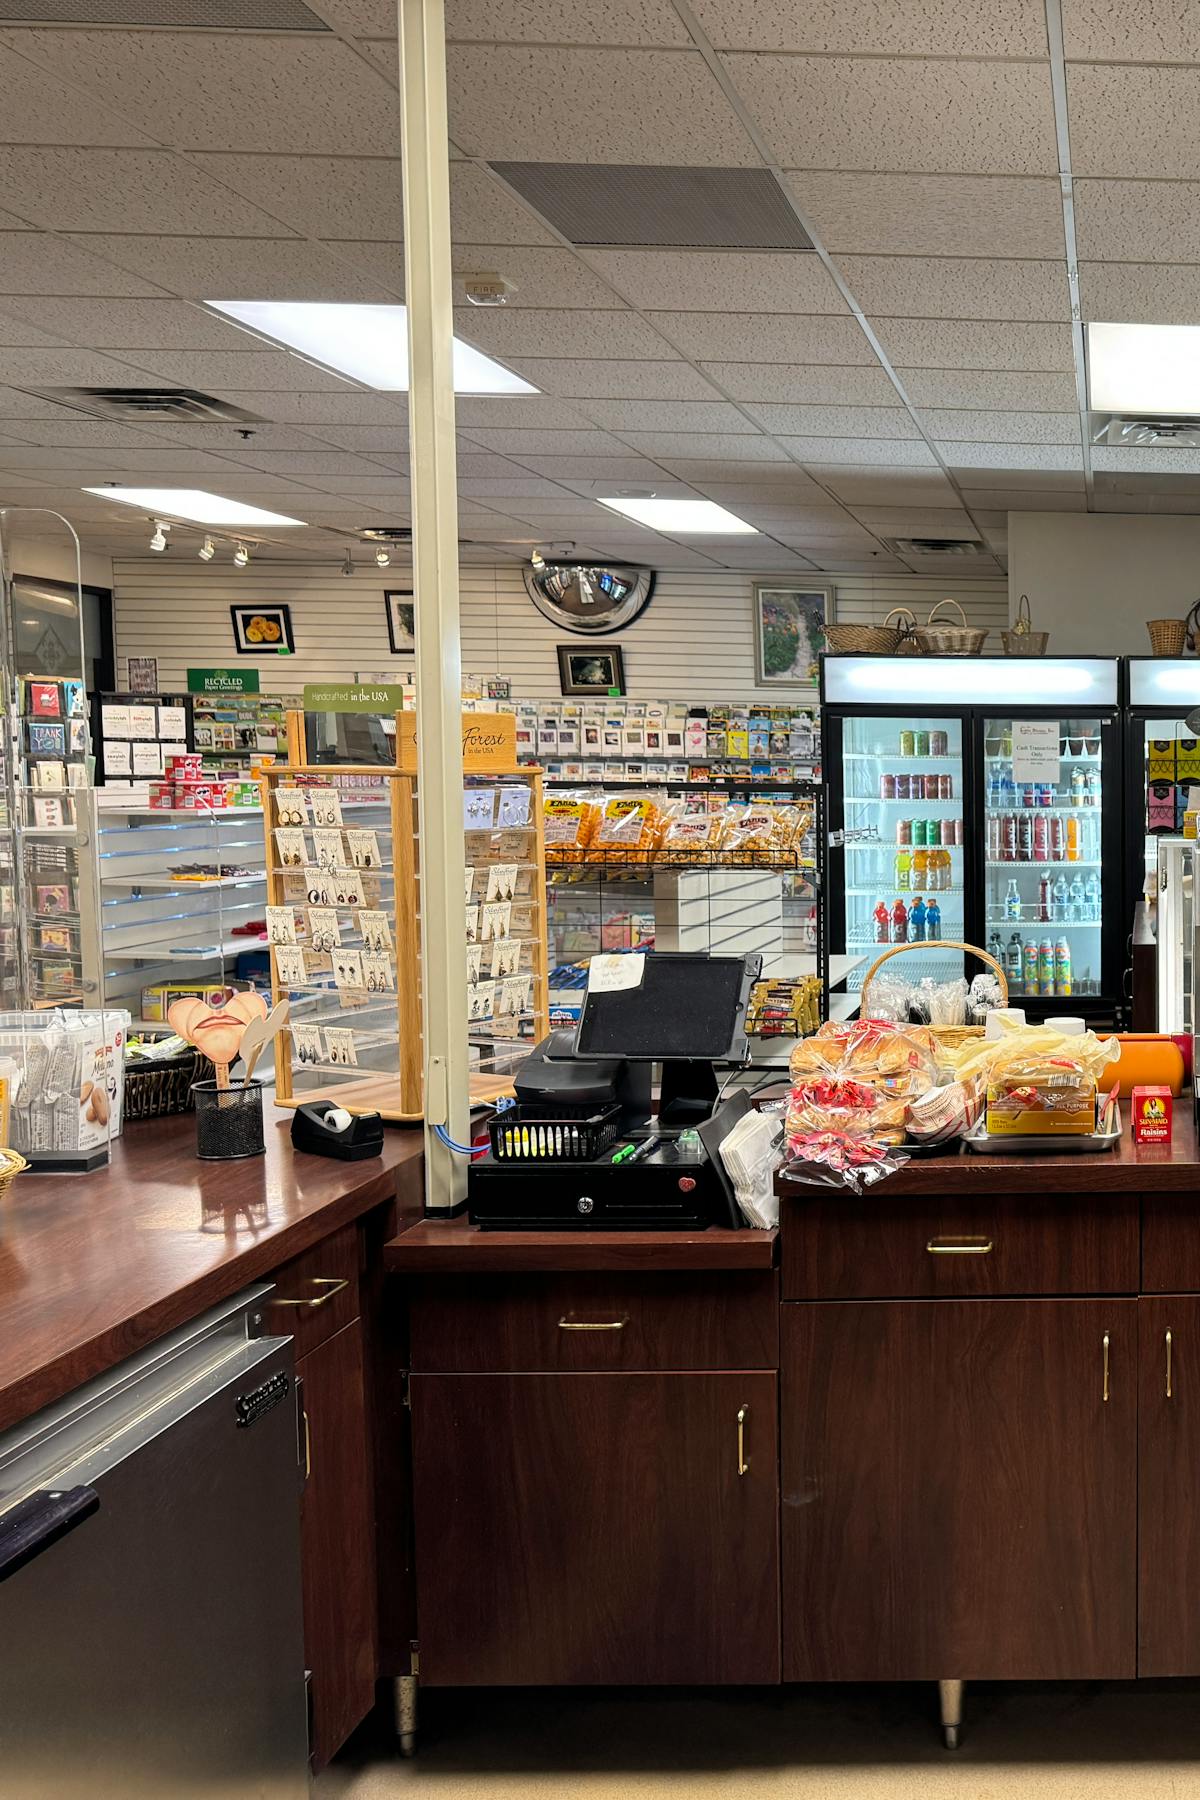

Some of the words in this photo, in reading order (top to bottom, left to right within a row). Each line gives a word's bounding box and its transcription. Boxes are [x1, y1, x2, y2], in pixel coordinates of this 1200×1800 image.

[204, 677, 243, 686] RECYCLED
[311, 691, 349, 701] Handcrafted
[350, 690, 358, 701] in
[359, 688, 370, 702] the
[371, 691, 389, 701] USA
[462, 726, 506, 757] Forest
[1066, 1102, 1090, 1110] PURPOSE
[1140, 1128, 1168, 1136] Raisins
